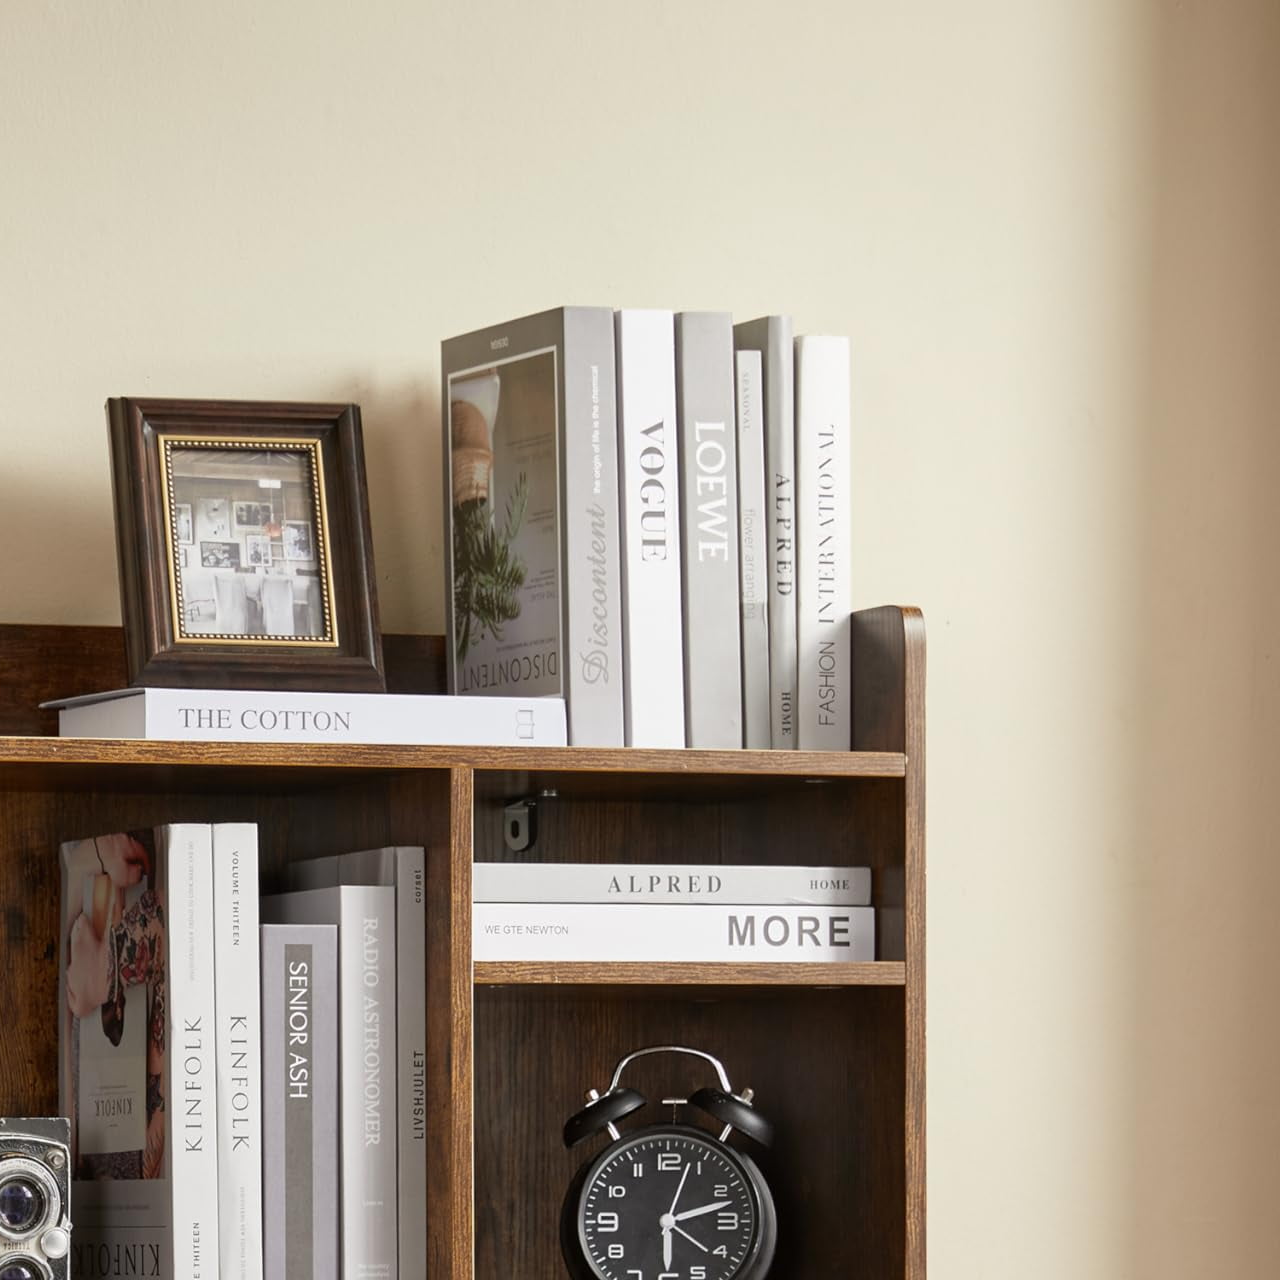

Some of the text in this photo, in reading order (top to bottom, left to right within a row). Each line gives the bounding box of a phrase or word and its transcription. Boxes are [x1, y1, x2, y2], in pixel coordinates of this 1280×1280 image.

[639, 418, 667, 563] VOGUE
[694, 420, 729, 563] LOEWE
[775, 472, 793, 597] ALPRED
[741, 508, 757, 620] flower arranging
[817, 423, 835, 727] FASHION INTERNATIONAL
[579, 503, 609, 686] Discontent
[460, 651, 558, 693] DISCONTENT
[178, 707, 353, 732] THE COTTON
[781, 691, 792, 738] HOME
[231, 851, 240, 946] VOLUME THITEEN
[414, 869, 422, 904] corset
[607, 875, 722, 893] ALPRED
[809, 879, 851, 891] HOME
[485, 924, 569, 935] WE GTE NEWTON
[727, 914, 851, 948] MORE
[289, 962, 308, 1098] SENIOR ASH
[363, 916, 381, 1148] RADIO ASTRONOMER
[184, 1016, 203, 1154] KINFOLK
[229, 1015, 250, 1153] KINFOLK
[413, 1049, 425, 1140] LIVSHJULET
[94, 1096, 133, 1118] KINFOLK
[633, 1163, 643, 1178] 11
[657, 1153, 682, 1171] 12
[697, 1161, 702, 1175] 1
[608, 1185, 626, 1198] 10
[713, 1184, 728, 1197] 2
[597, 1212, 619, 1233] 9
[717, 1212, 739, 1230] 3
[73, 1243, 161, 1277] KINFOLK
[192, 1222, 201, 1265] THITEEN
[607, 1244, 624, 1259] 8
[712, 1244, 728, 1259] 4
[690, 1265, 706, 1280] 5
